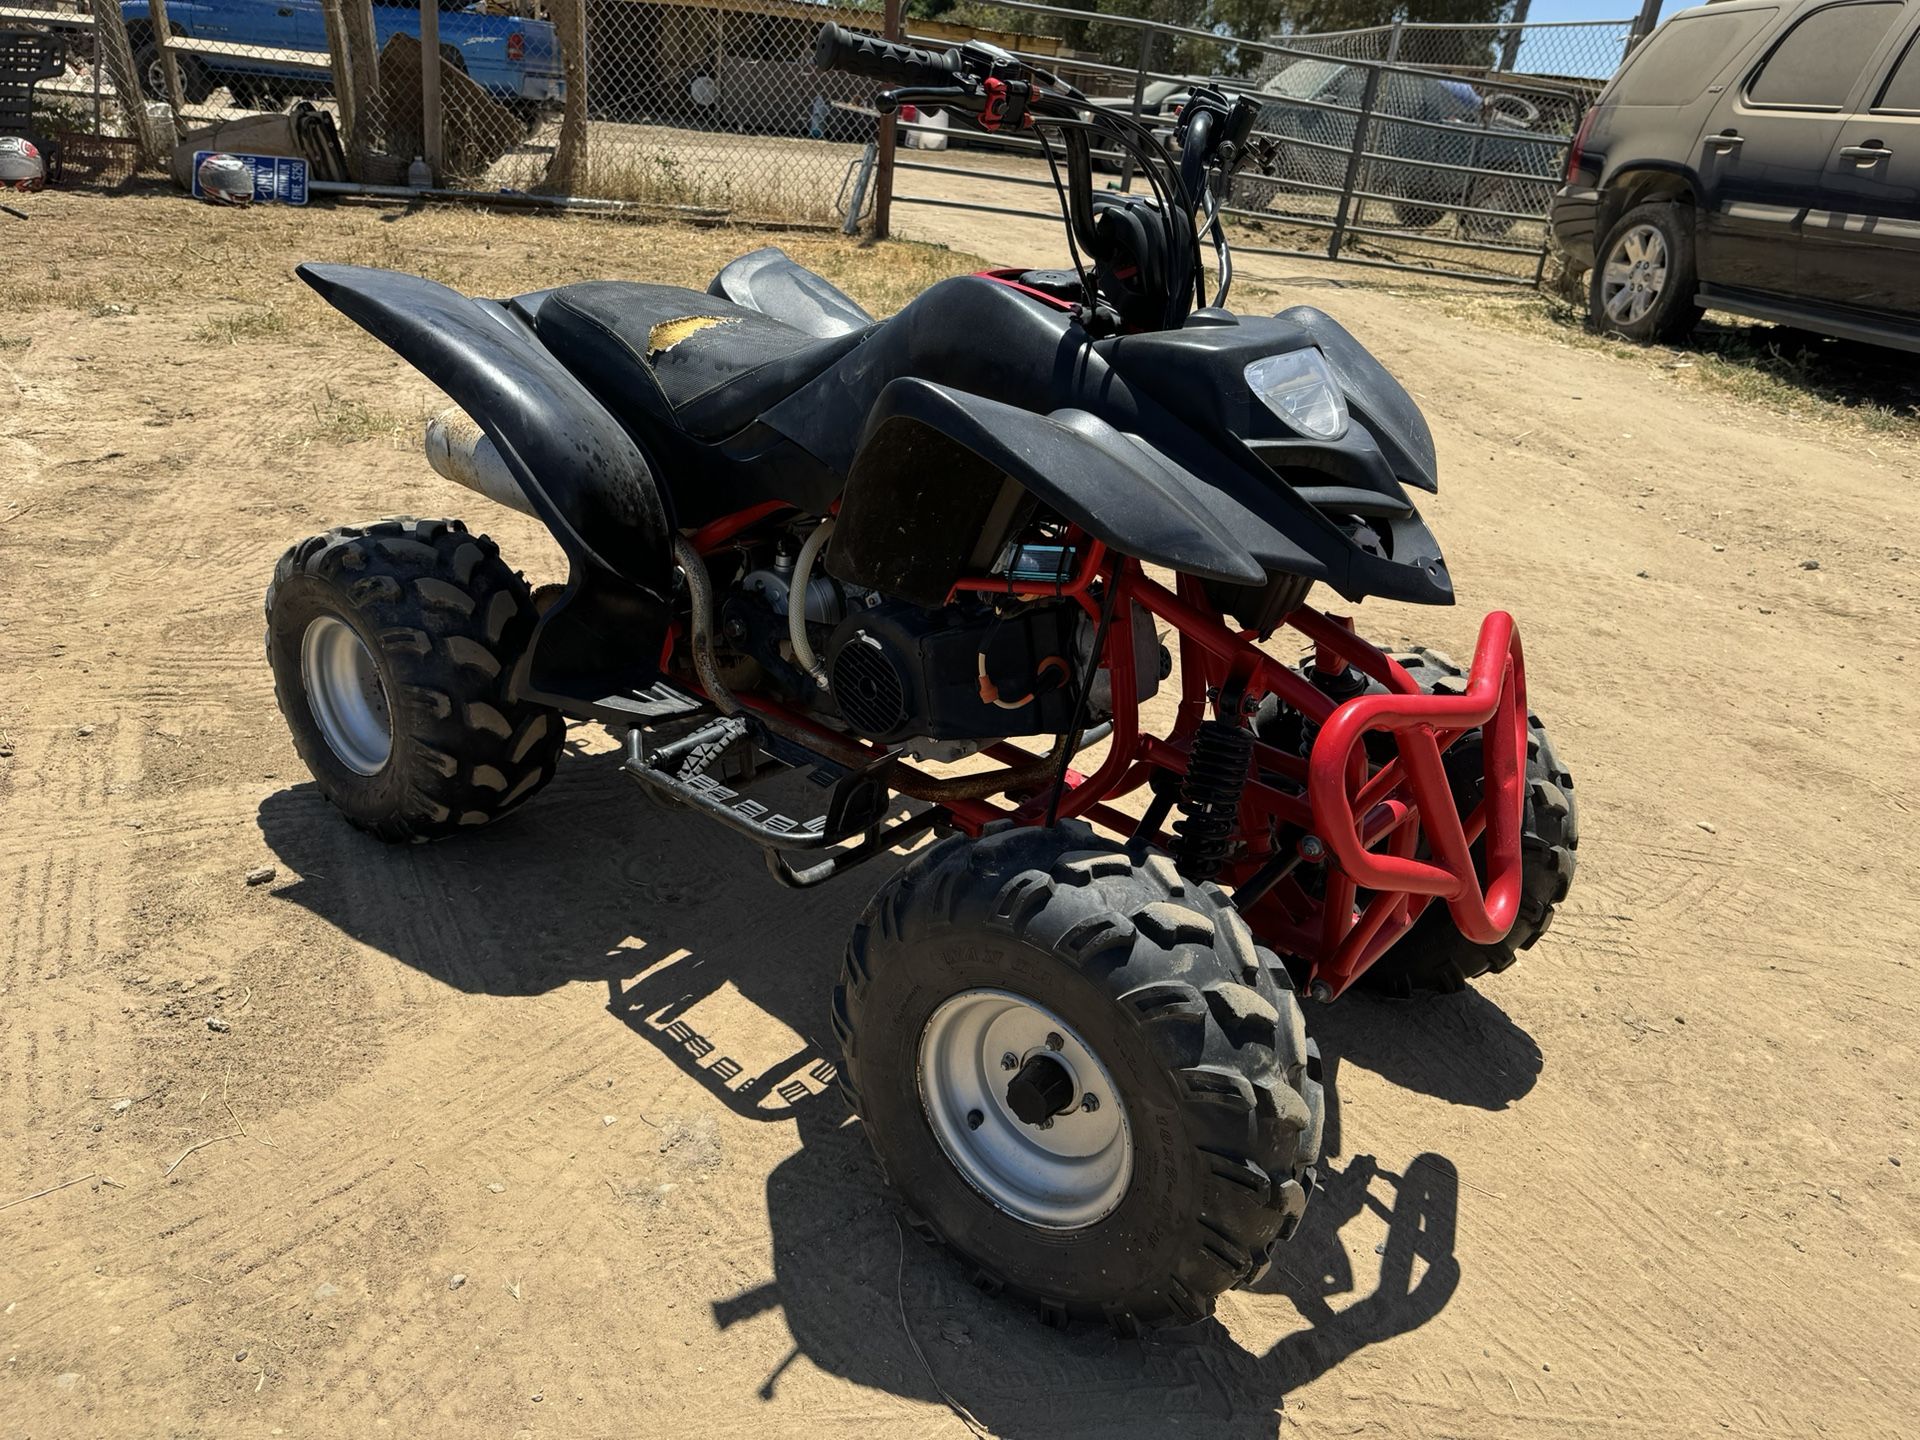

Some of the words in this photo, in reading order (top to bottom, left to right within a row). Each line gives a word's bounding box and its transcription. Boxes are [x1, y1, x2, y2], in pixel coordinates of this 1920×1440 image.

[257, 165, 273, 193] ONLY
[278, 164, 290, 196] MINIMUM
[291, 162, 304, 182] $250
[291, 183, 303, 201] FINE
